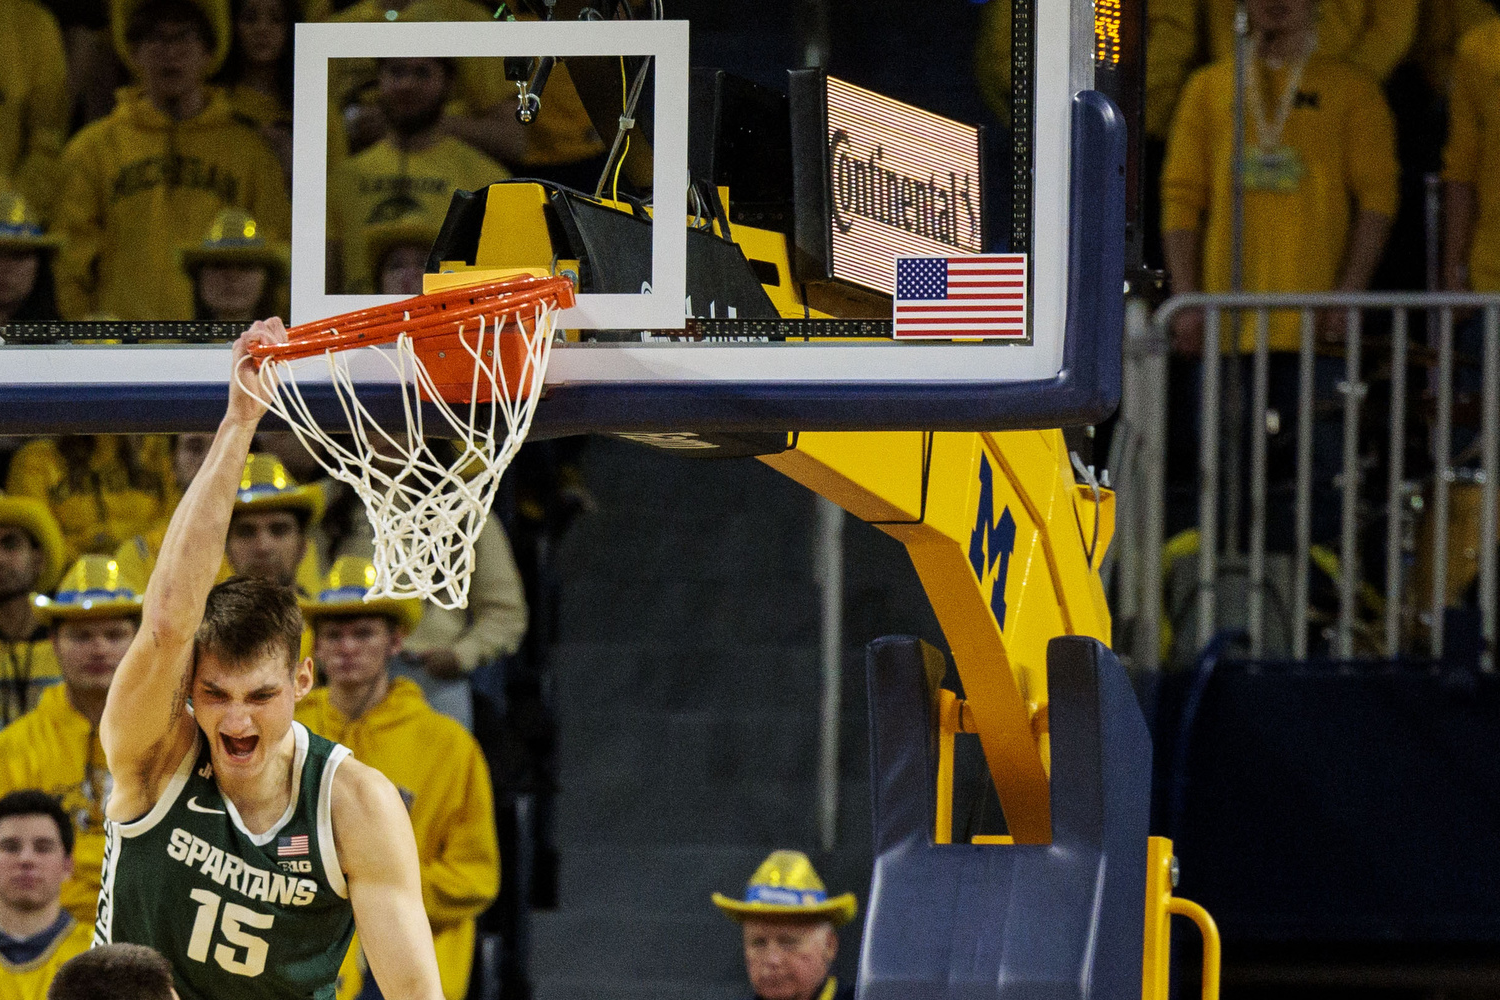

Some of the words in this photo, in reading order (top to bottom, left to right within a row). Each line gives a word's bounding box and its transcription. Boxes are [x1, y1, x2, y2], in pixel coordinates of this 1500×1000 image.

[828, 130, 957, 247] Continental
[167, 828, 318, 906] SPARTANS
[187, 887, 275, 978] 15
